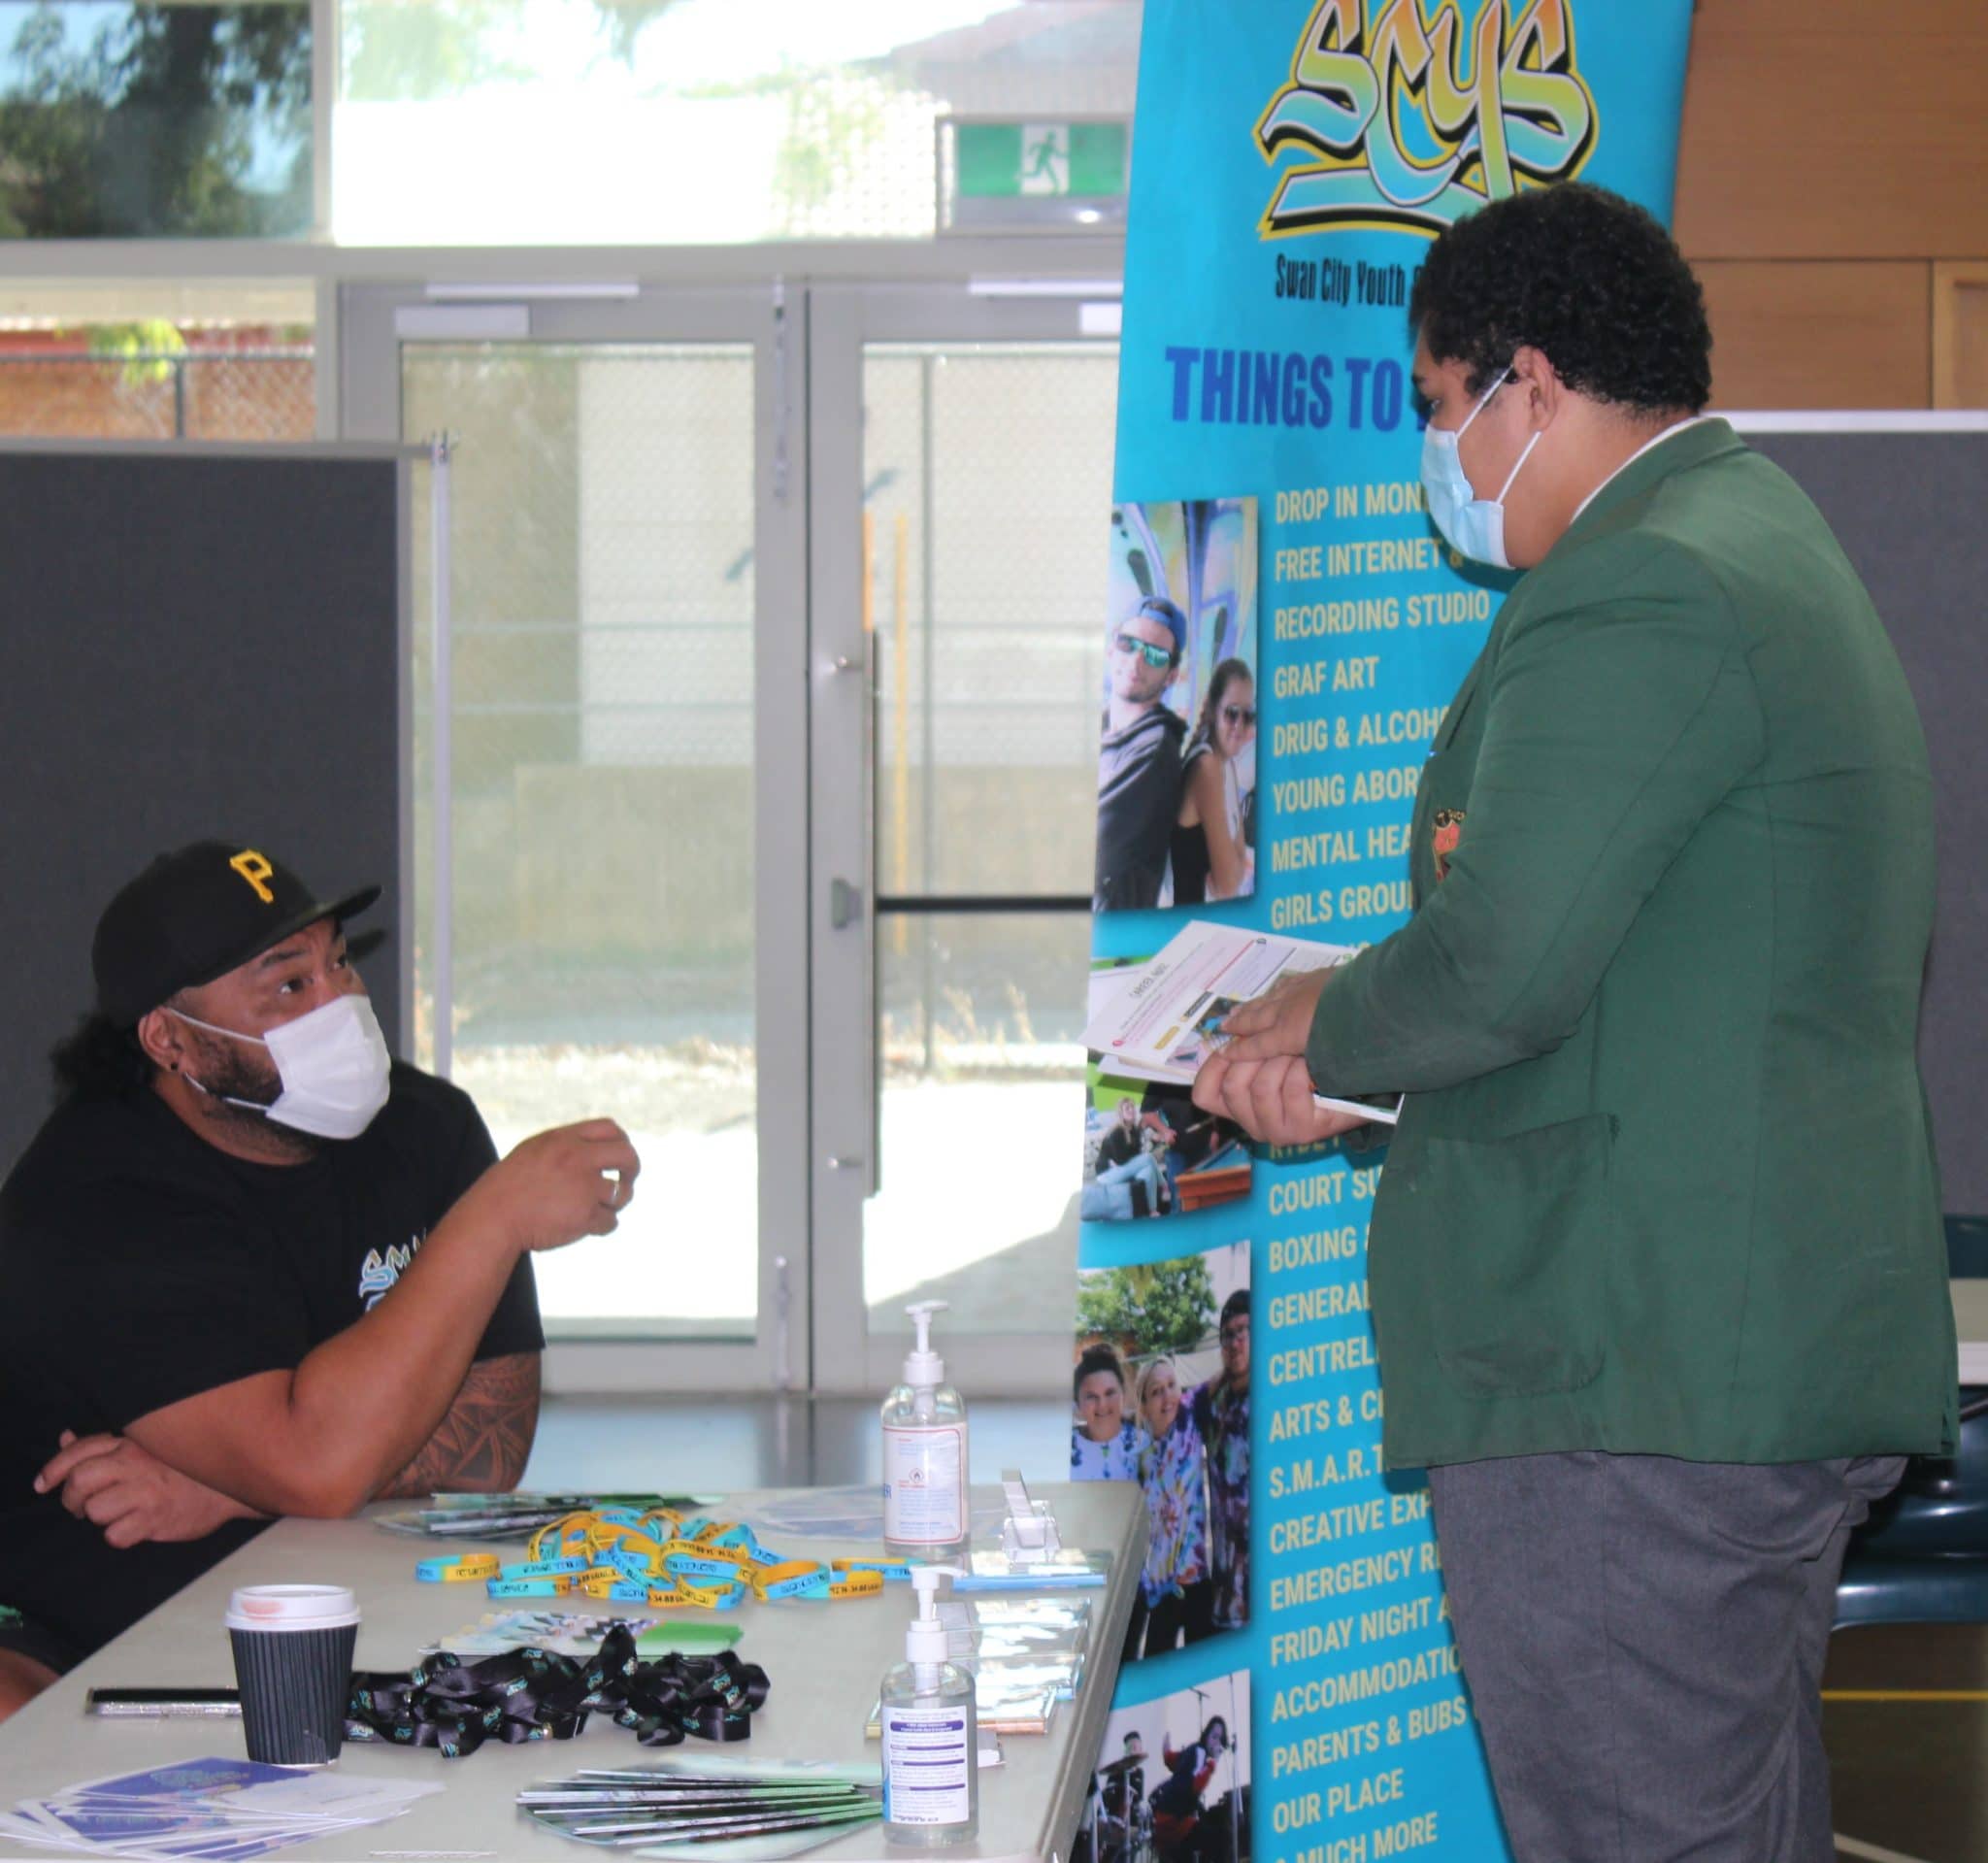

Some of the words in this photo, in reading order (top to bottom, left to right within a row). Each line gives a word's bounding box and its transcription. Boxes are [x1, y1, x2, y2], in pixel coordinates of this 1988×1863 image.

[1276, 253, 1316, 301] Swan
[1321, 258, 1351, 307] City
[1358, 261, 1406, 308] Youth
[1165, 346, 1334, 428] THINGS
[1345, 356, 1404, 432] TO
[1276, 486, 1330, 524] DROP
[1336, 484, 1358, 518] IN
[1275, 545, 1322, 582] FREE
[1328, 537, 1443, 576] INTERNET
[1275, 597, 1400, 642] RECORDING
[1407, 589, 1491, 627] STUDIO
[1274, 660, 1327, 699] GRAF
[1333, 655, 1380, 692] ART
[1273, 718, 1329, 758] DRUG
[1335, 715, 1350, 749] &
[1273, 773, 1346, 815] YOUNG
[1352, 765, 1423, 805] ABOR
[229, 848, 274, 904] P
[1272, 830, 1362, 873] MENTAL
[1271, 889, 1333, 930] GIRLS
[1268, 1171, 1346, 1215] COURT
[1269, 1225, 1357, 1274] BOXING
[1269, 1399, 1330, 1444] ARTS
[1337, 1394, 1354, 1426] &
[1270, 1499, 1385, 1554] CREATIVE
[1270, 1547, 1413, 1612] EMERGENCY
[1270, 1615, 1354, 1668] FRIDAY
[1361, 1596, 1433, 1644] NIGHT
[1272, 1720, 1379, 1779] PARENTS
[1385, 1714, 1402, 1746] &
[1408, 1695, 1468, 1741] BUBS
[1273, 1792, 1321, 1834] OUR
[1327, 1768, 1405, 1818] PLACE
[1373, 1811, 1439, 1860] MORE
